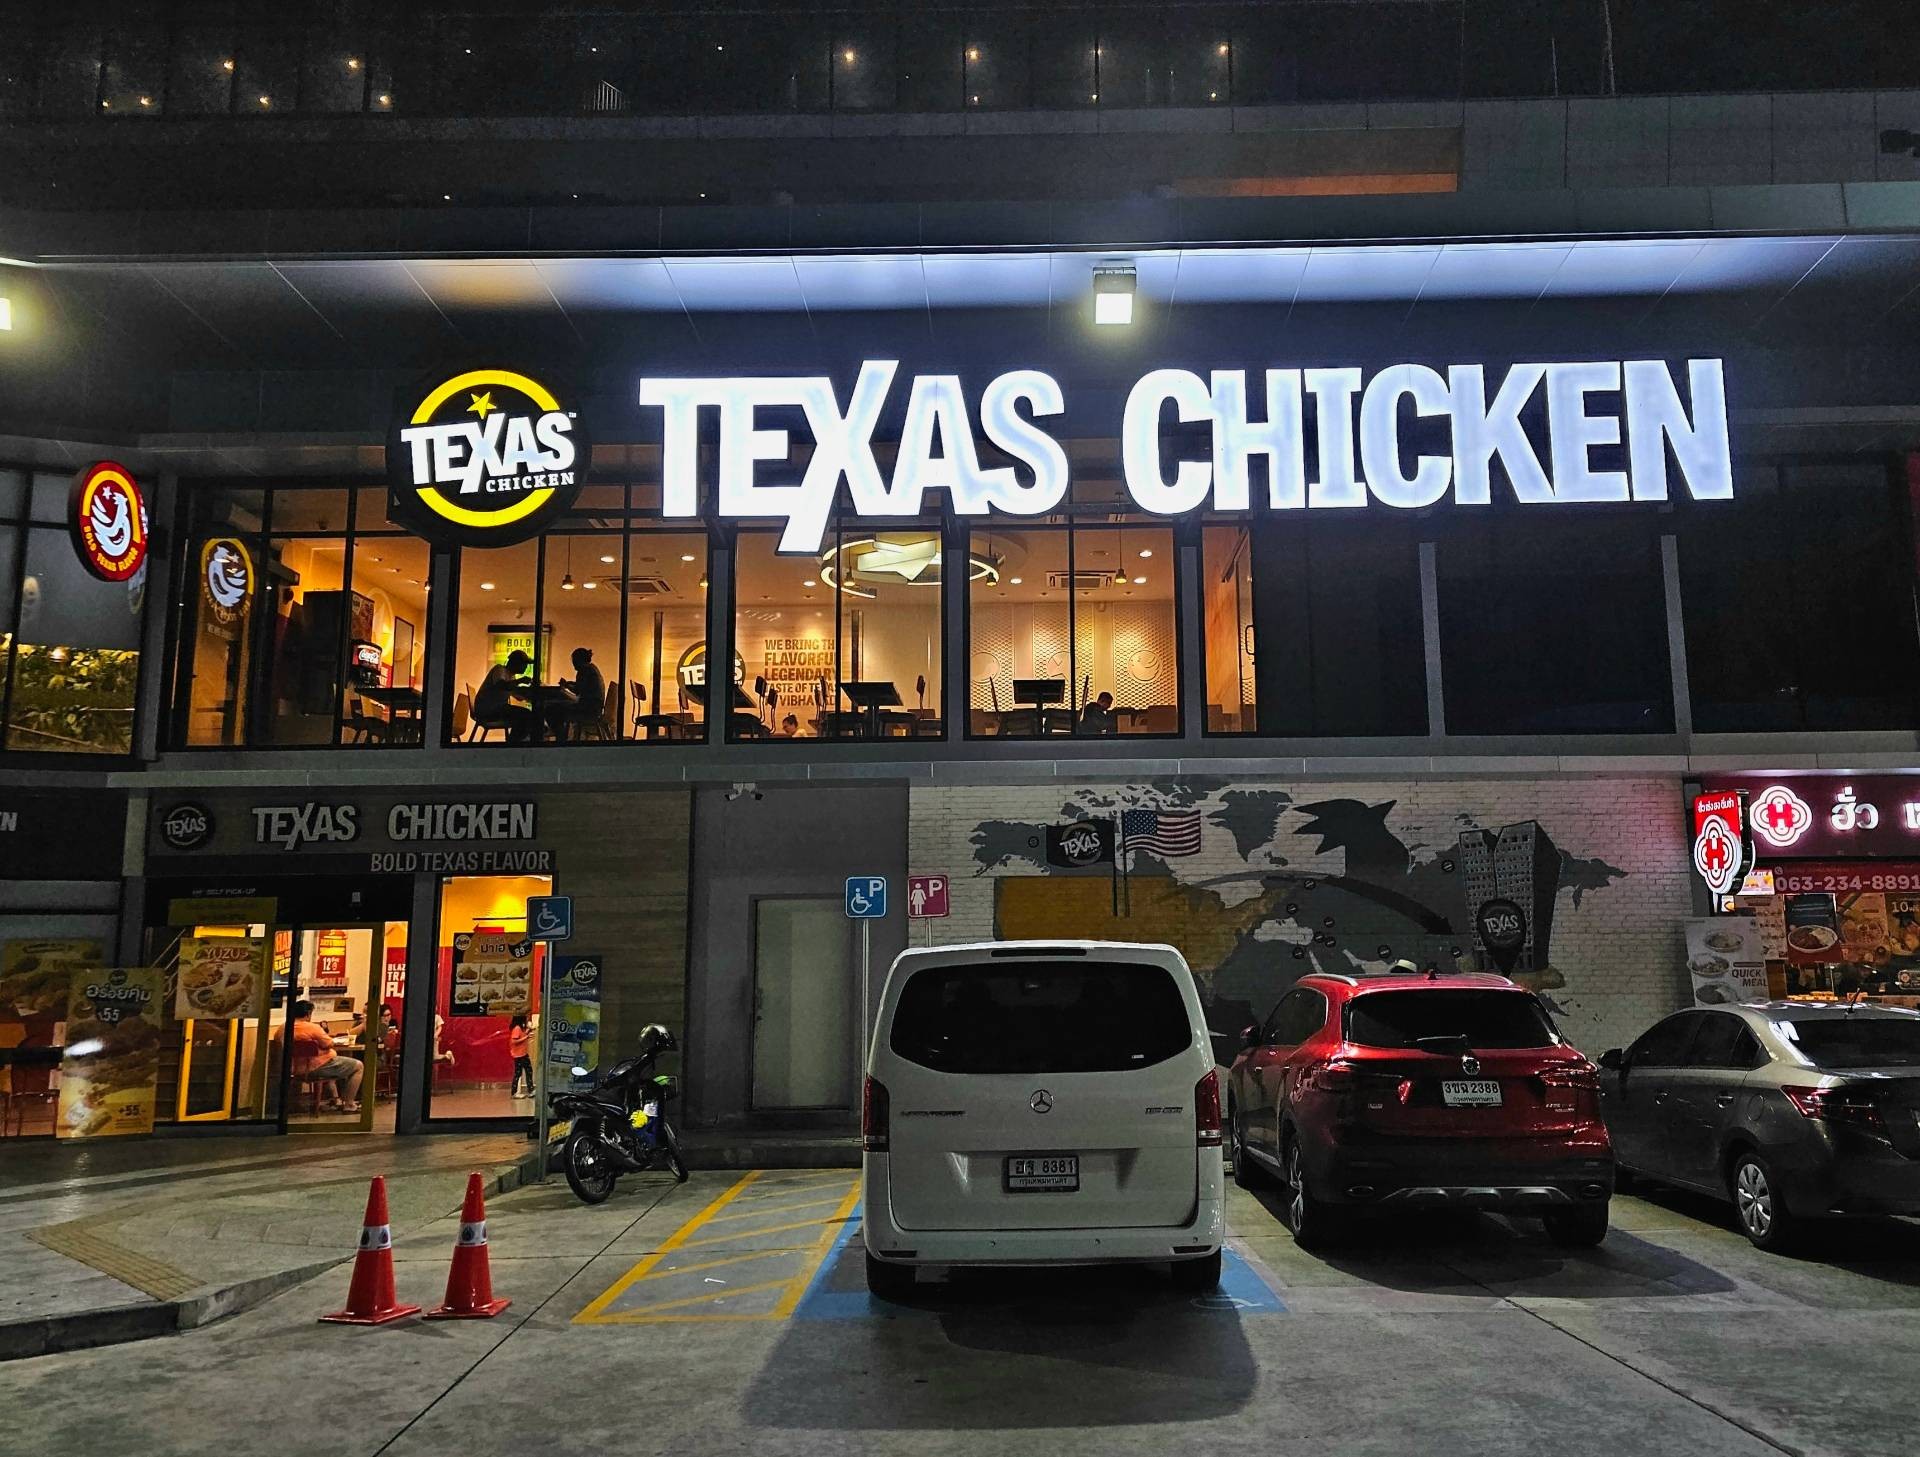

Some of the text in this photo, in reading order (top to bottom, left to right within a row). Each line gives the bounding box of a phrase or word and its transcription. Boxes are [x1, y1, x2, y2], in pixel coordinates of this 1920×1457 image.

[401, 412, 576, 494] TEXAS
[639, 358, 1735, 553] TEXAS CHICKEN
[485, 472, 574, 493] CHICKEN
[507, 639, 531, 647] BOLD
[765, 639, 835, 650] WE BRING TH
[765, 652, 835, 666] FLAVORFU
[795, 683, 807, 693] OF
[164, 817, 207, 838] TEXAS
[252, 802, 534, 850] TEXAS CHICKEN
[1060, 833, 1100, 857] TEXAS
[371, 851, 550, 872] BOLD TEXAS FLAVOR
[869, 880, 883, 897] P
[929, 880, 943, 897] P
[1775, 875, 1920, 892] 063-234-8891
[1484, 914, 1519, 937] TEXAS
[573, 966, 598, 978] TEXAS
[1732, 969, 1762, 978] QUICK
[1742, 978, 1768, 988] MEAL
[1470, 1082, 1499, 1094] 2388
[1042, 1159, 1075, 1174] 8381
